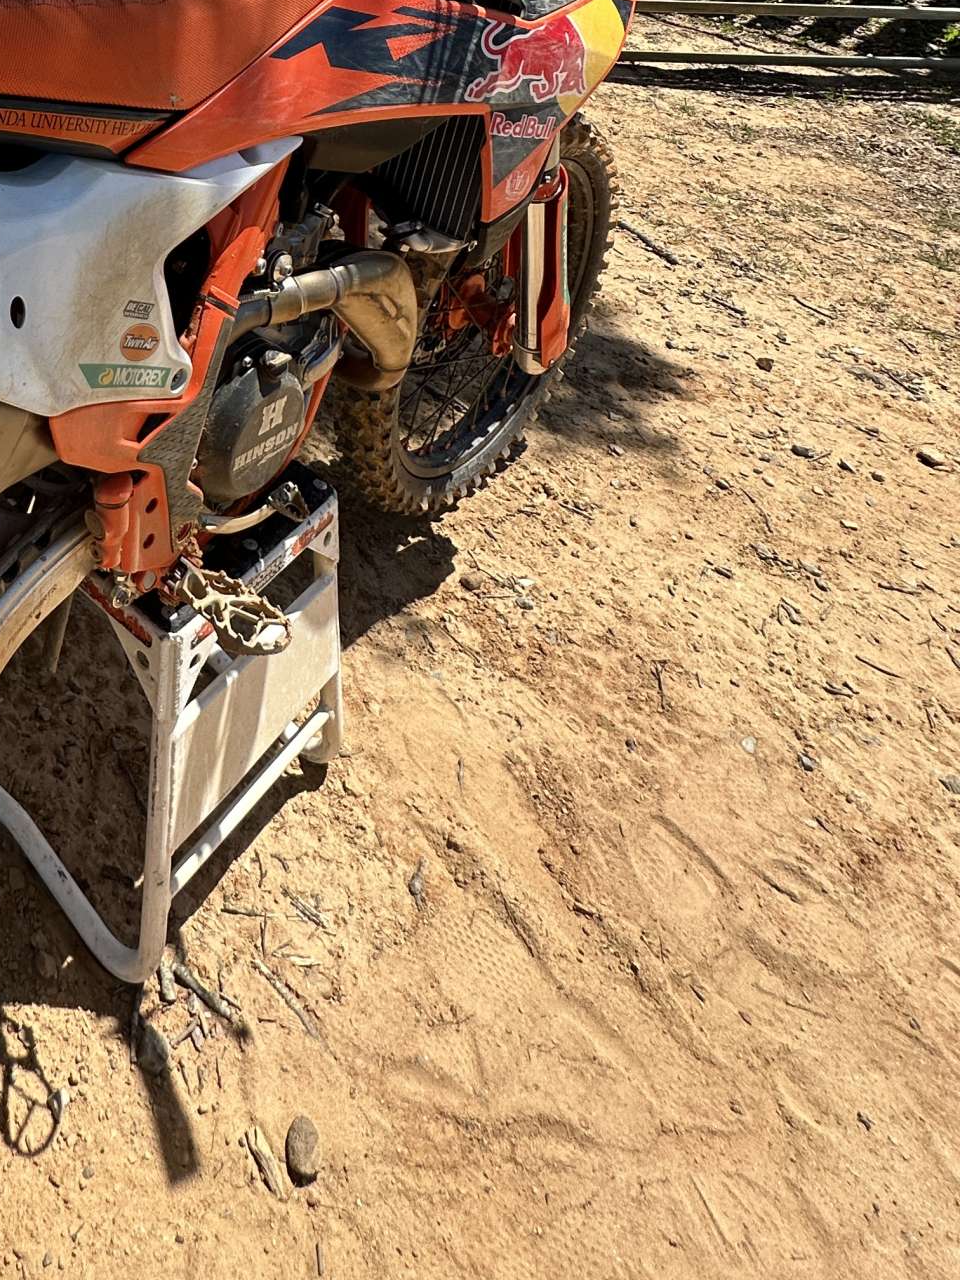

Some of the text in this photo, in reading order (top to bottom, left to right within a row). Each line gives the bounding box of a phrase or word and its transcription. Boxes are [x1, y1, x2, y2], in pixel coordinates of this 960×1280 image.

[31, 113, 108, 133] UNIVERSITY
[111, 122, 155, 136] HEAL
[113, 367, 166, 386] MOTOREX
[233, 422, 299, 472] HINSON
